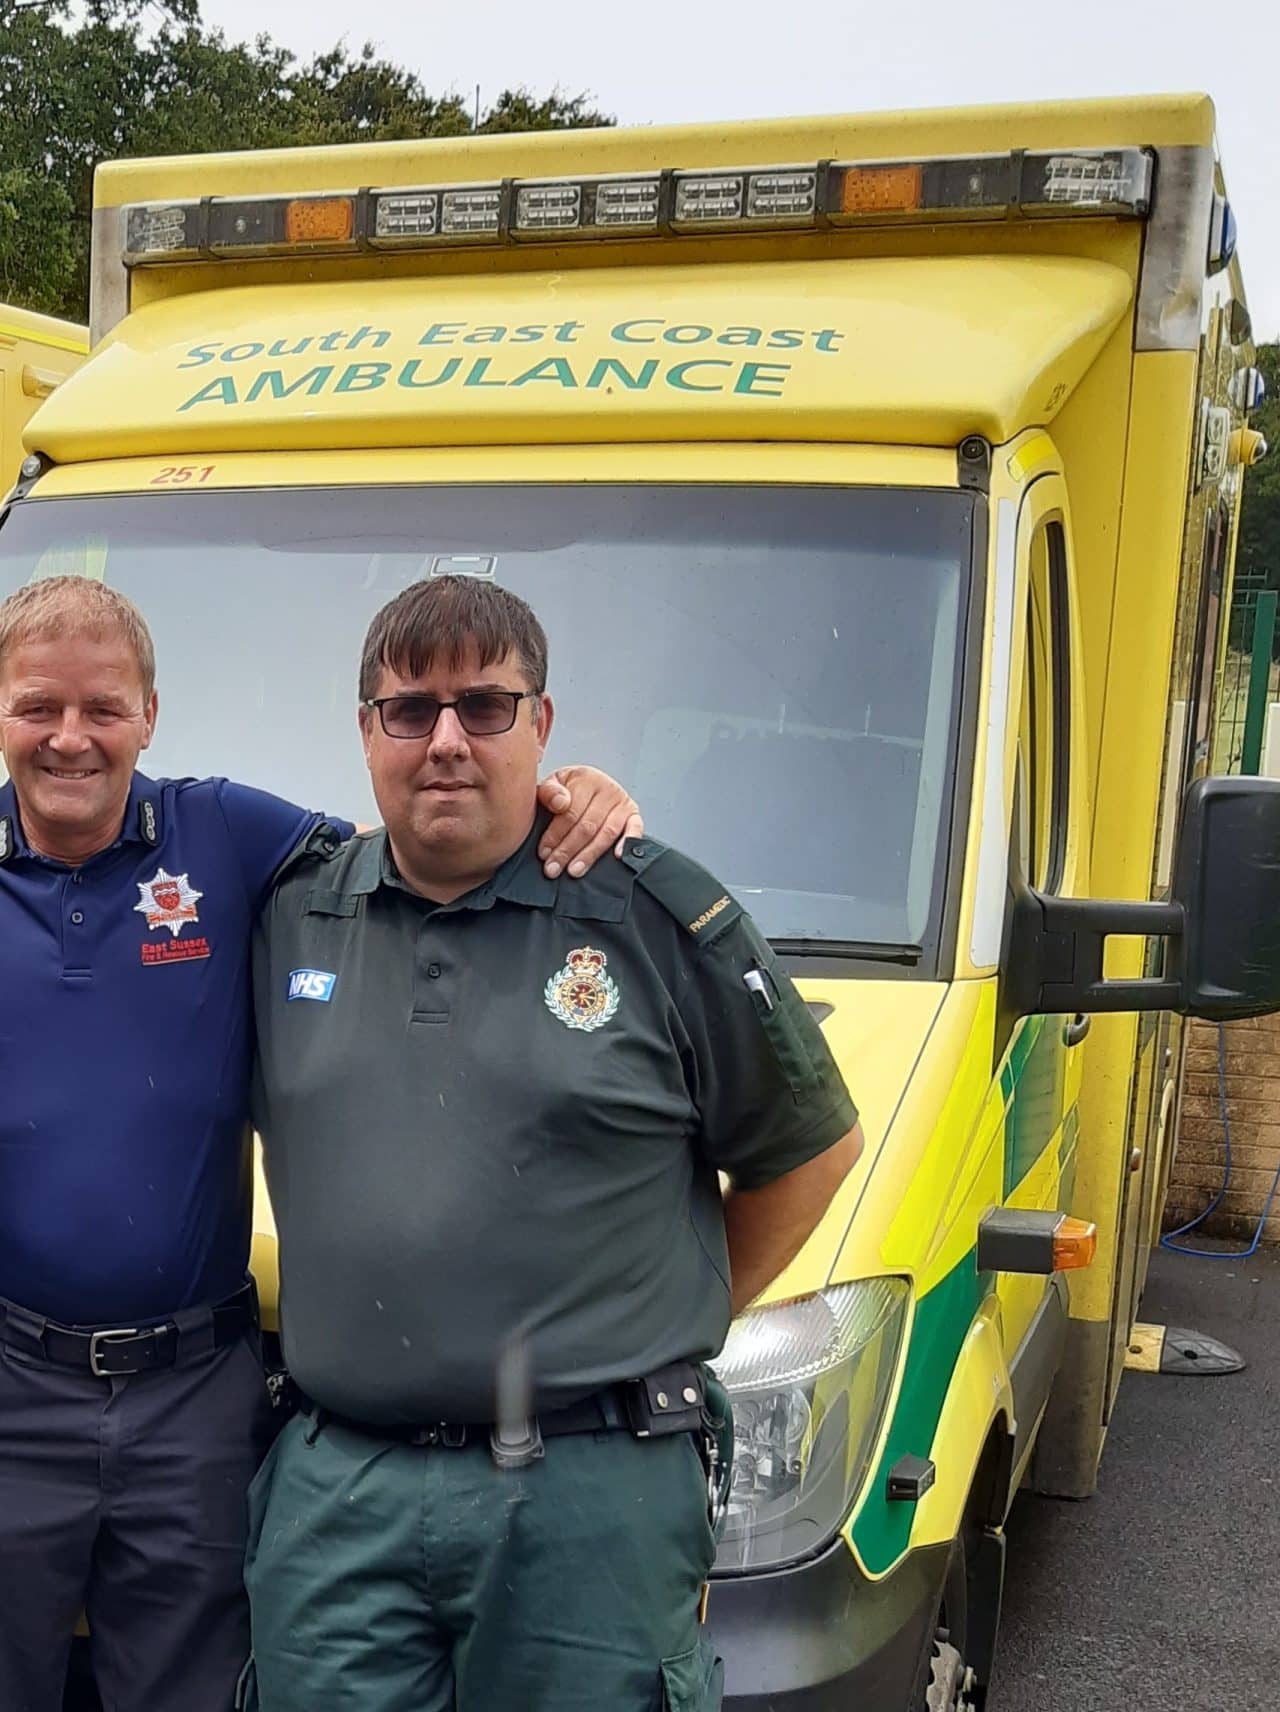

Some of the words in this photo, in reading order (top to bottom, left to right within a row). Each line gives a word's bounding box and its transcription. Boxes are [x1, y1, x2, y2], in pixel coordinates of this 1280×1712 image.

[177, 326, 391, 369] South
[418, 320, 585, 345] East
[611, 319, 845, 352] Coast
[176, 357, 791, 412] AMBULANCE
[149, 465, 217, 485] 251
[689, 895, 731, 933] PARAMEDIC
[141, 942, 167, 954] East
[169, 937, 208, 950] Sussex
[289, 972, 331, 997] NHS
